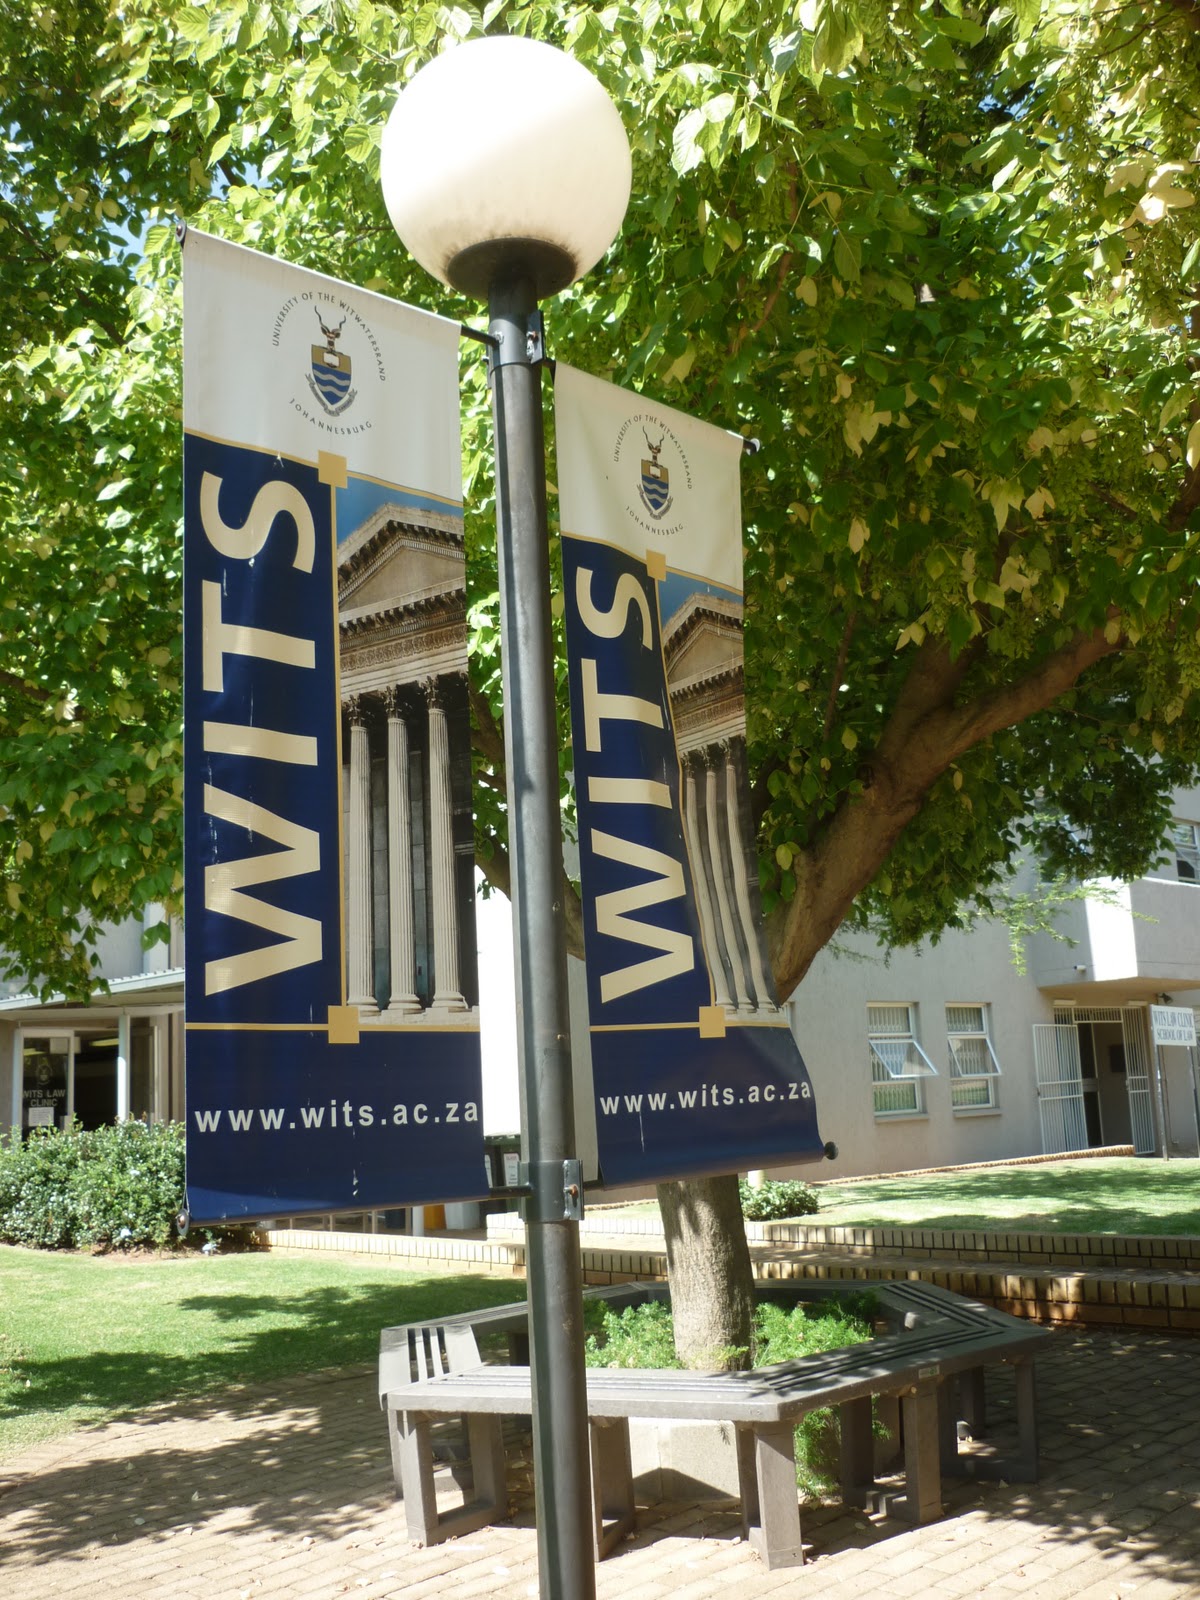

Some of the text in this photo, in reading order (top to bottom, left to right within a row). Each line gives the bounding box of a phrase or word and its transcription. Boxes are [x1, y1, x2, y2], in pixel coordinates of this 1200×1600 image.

[272, 292, 386, 381] UNIVERSITY OF THE WITWATERSRAND
[289, 398, 372, 435] JOHANNESBURG
[613, 414, 693, 490] UNIVERSITY OF THE WITWATERSRAND
[625, 506, 684, 536] JOHANNESBURG
[200, 470, 324, 997] WITS
[575, 566, 696, 1005] WITS
[30, 1098, 57, 1107] CLINIC
[46, 1089, 66, 1098] LAW
[600, 1081, 811, 1115] www.wits.ac.za
[194, 1099, 479, 1133] www.wits.ac.za
